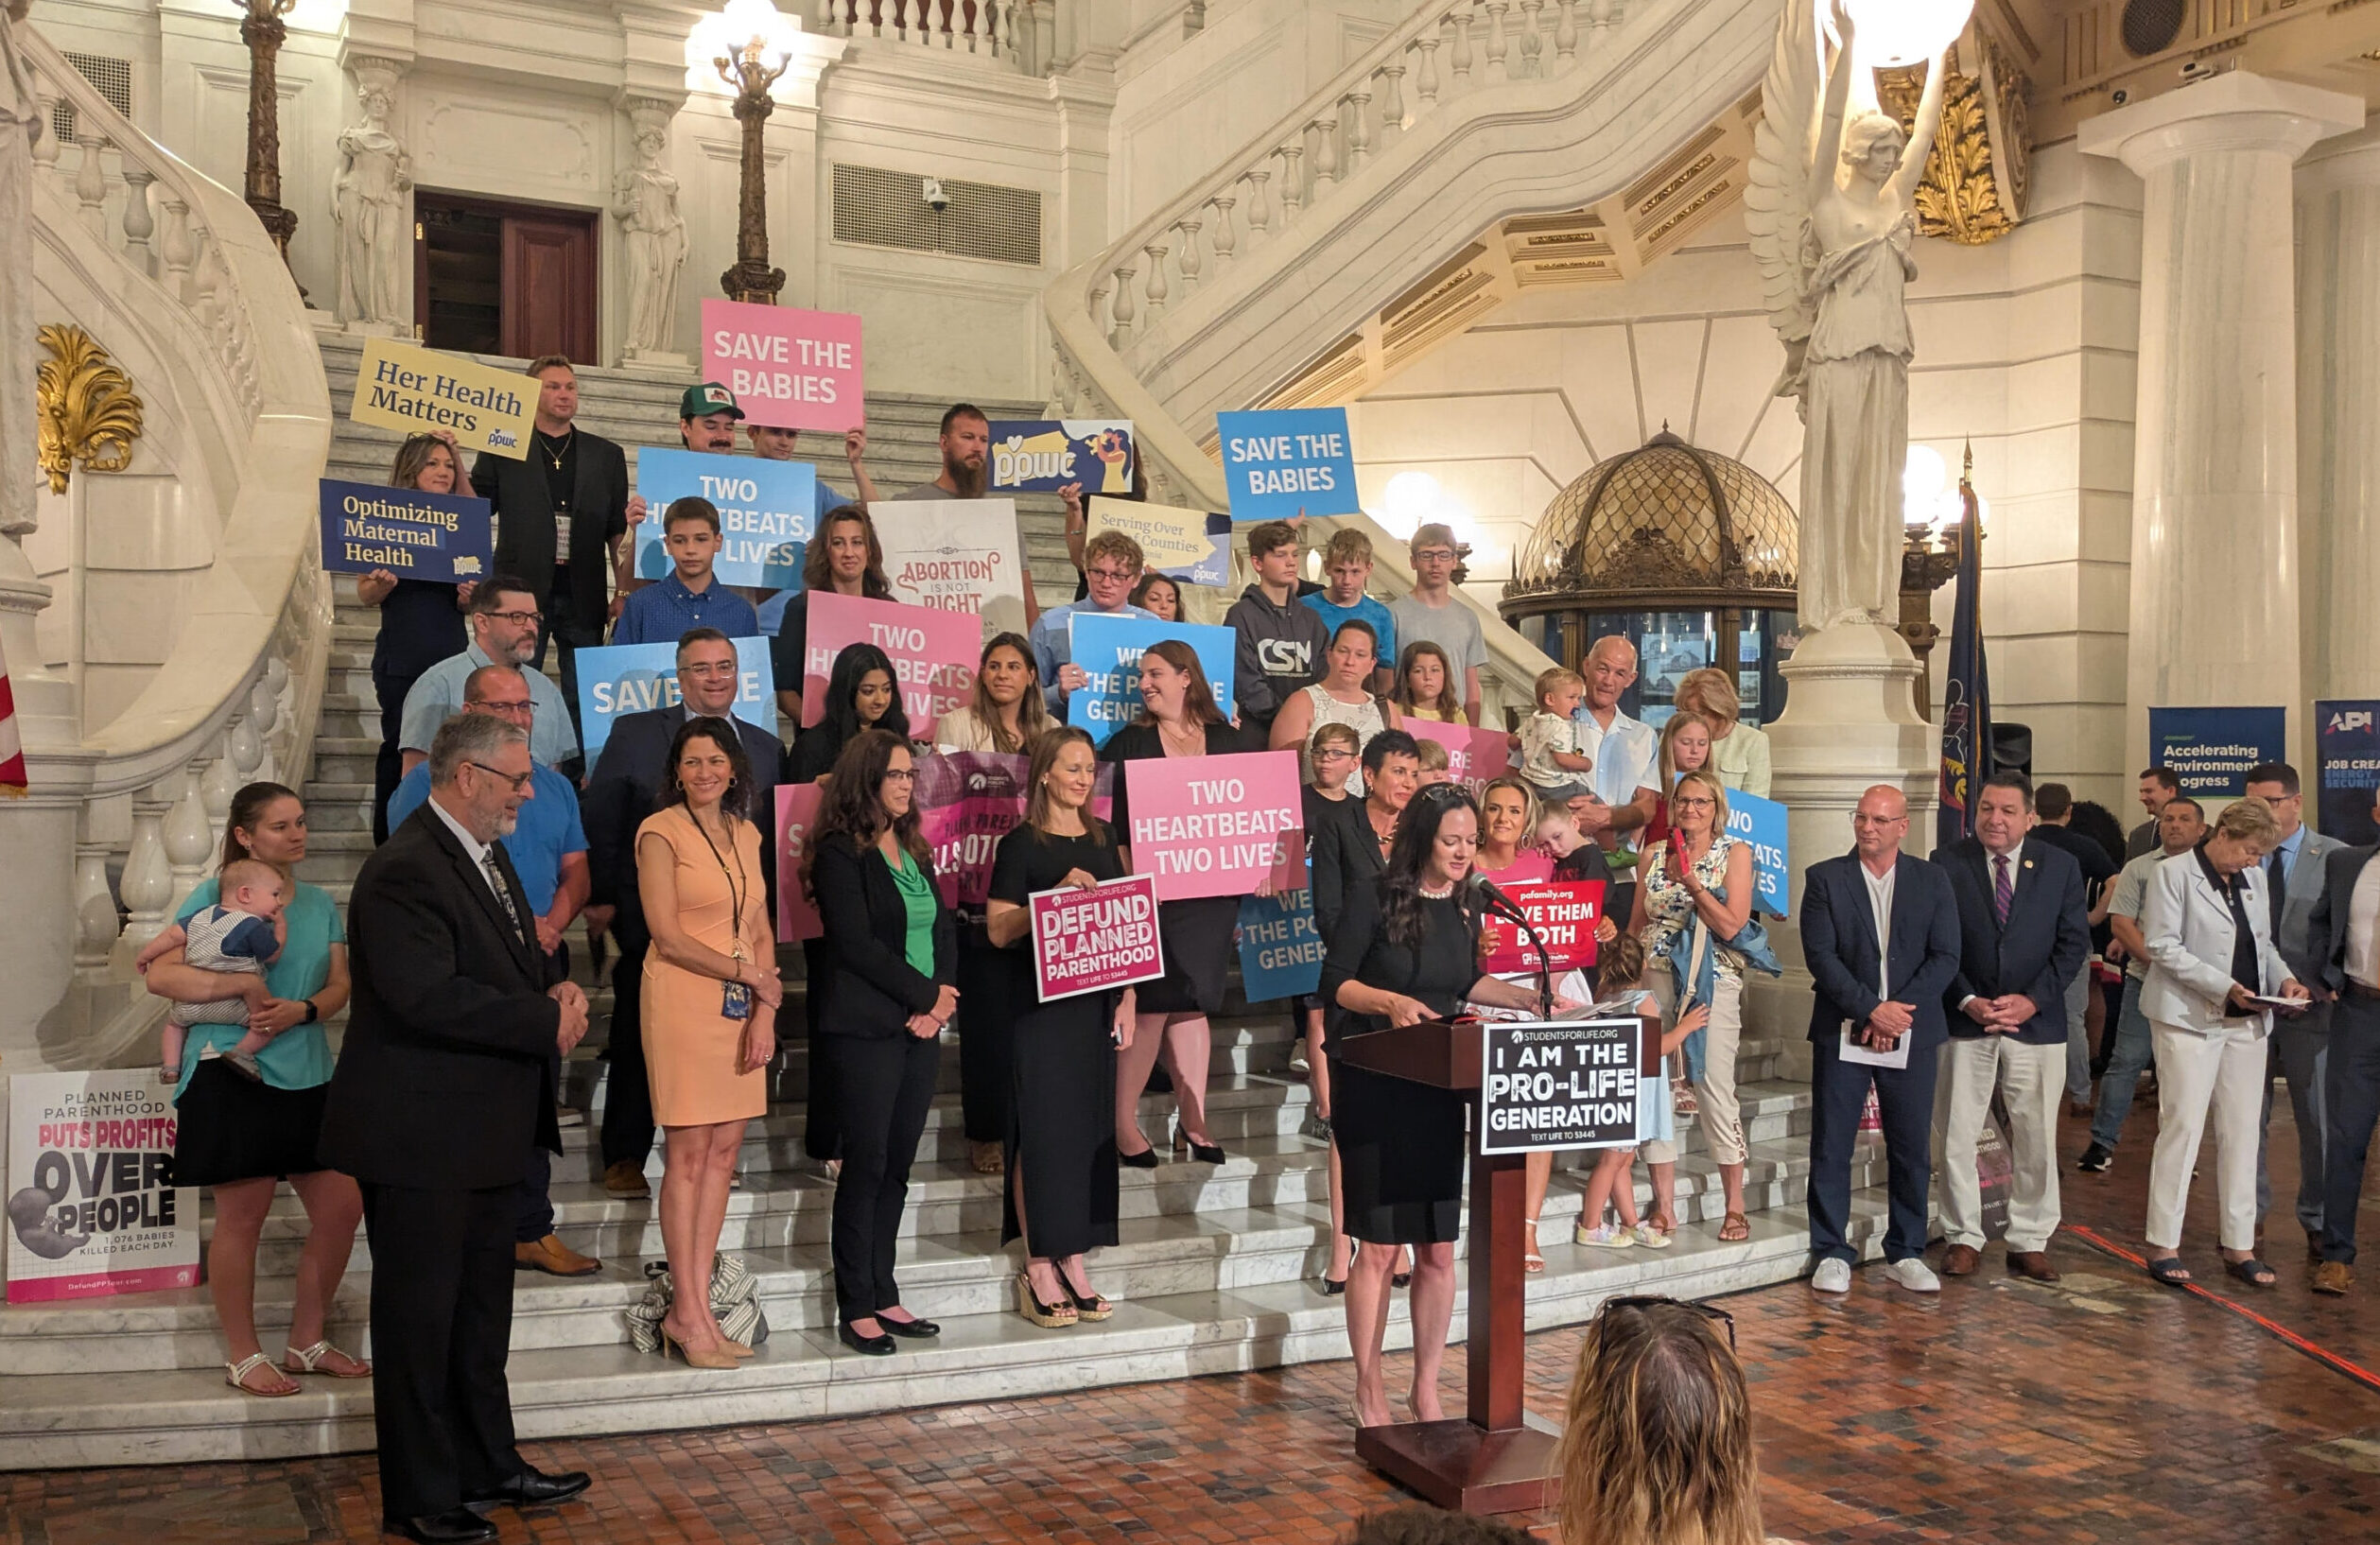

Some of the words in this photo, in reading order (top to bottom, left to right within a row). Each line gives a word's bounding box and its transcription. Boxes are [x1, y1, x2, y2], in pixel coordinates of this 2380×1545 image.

[714, 330, 790, 364] SAVE
[796, 339, 852, 370] THE
[374, 359, 427, 391] Her
[433, 374, 522, 417] Health
[732, 369, 838, 405] BABIES
[368, 386, 478, 431] Matters
[487, 431, 519, 448] ppwc
[1231, 437, 1293, 463] SAVE
[1300, 433, 1344, 458] THE
[994, 450, 1077, 487] ppwc
[1249, 466, 1335, 495] BABIES
[699, 476, 757, 502] TWO
[343, 495, 460, 531] Optimizing
[643, 502, 813, 541] HBEATS,
[1101, 513, 1152, 534] Serving
[1154, 522, 1184, 536] Over
[344, 519, 438, 547] Maternal
[1142, 535, 1200, 553] Counties
[344, 543, 413, 567] Health
[725, 539, 795, 566] LIVES
[896, 551, 1000, 594] ABORTION
[930, 584, 942, 593] IS
[947, 582, 970, 592] NOT
[869, 622, 927, 652] TWO
[810, 647, 971, 690] HBEATS
[593, 679, 684, 714] SAVE
[907, 692, 960, 719] IVES
[2324, 712, 2372, 735] API
[1449, 750, 1472, 770] RE
[2163, 744, 2258, 758] Accelerating
[2163, 759, 2273, 772] Environment
[2324, 760, 2349, 770] JOB
[2351, 760, 2380, 770] CREA
[2325, 770, 2372, 778] ENERGY
[1188, 779, 1244, 805] TWO
[2180, 776, 2230, 789] ogress
[1135, 808, 1301, 843] HEARTBEATS,
[1154, 848, 1213, 875] TWO
[1220, 842, 1287, 870] LIVES
[1062, 884, 1137, 904] STUDENTSFORLIFE.ORG
[1277, 889, 1312, 912] WE
[1520, 890, 1573, 901] pafamily.org
[1041, 894, 1151, 939] DEFUND
[1495, 906, 1543, 924] LVE
[1547, 902, 1593, 922] THEM
[1044, 921, 1154, 963] PLANNED
[1245, 919, 1290, 945] THE
[1517, 925, 1576, 946] BOTH
[1046, 946, 1155, 981] PARENTHOOD
[1259, 940, 1328, 970] GENER
[1076, 977, 1089, 985] TEXT
[1090, 975, 1102, 983] LIFE
[1523, 1030, 1618, 1042] STUDENTSFORLIFE.ORG
[1497, 1048, 1503, 1068] I
[1518, 1046, 1561, 1068] AM
[1575, 1043, 1628, 1065] THE
[65, 1090, 146, 1104] PLANNED
[1488, 1068, 1636, 1102] PRO-LIFE
[44, 1102, 165, 1119] PARENTHOOD
[1490, 1102, 1632, 1131] GENERATION
[39, 1121, 92, 1149] PUTS
[1548, 1133, 1562, 1141] LIFE
[1574, 1130, 1595, 1138] 53445
[34, 1150, 176, 1205] OVER
[57, 1189, 176, 1235] PEOPLE
[79, 1245, 116, 1256] KILLED
[121, 1242, 149, 1252] EACH
[105, 1235, 133, 1245] 1,076
[136, 1231, 175, 1241] BABIES
